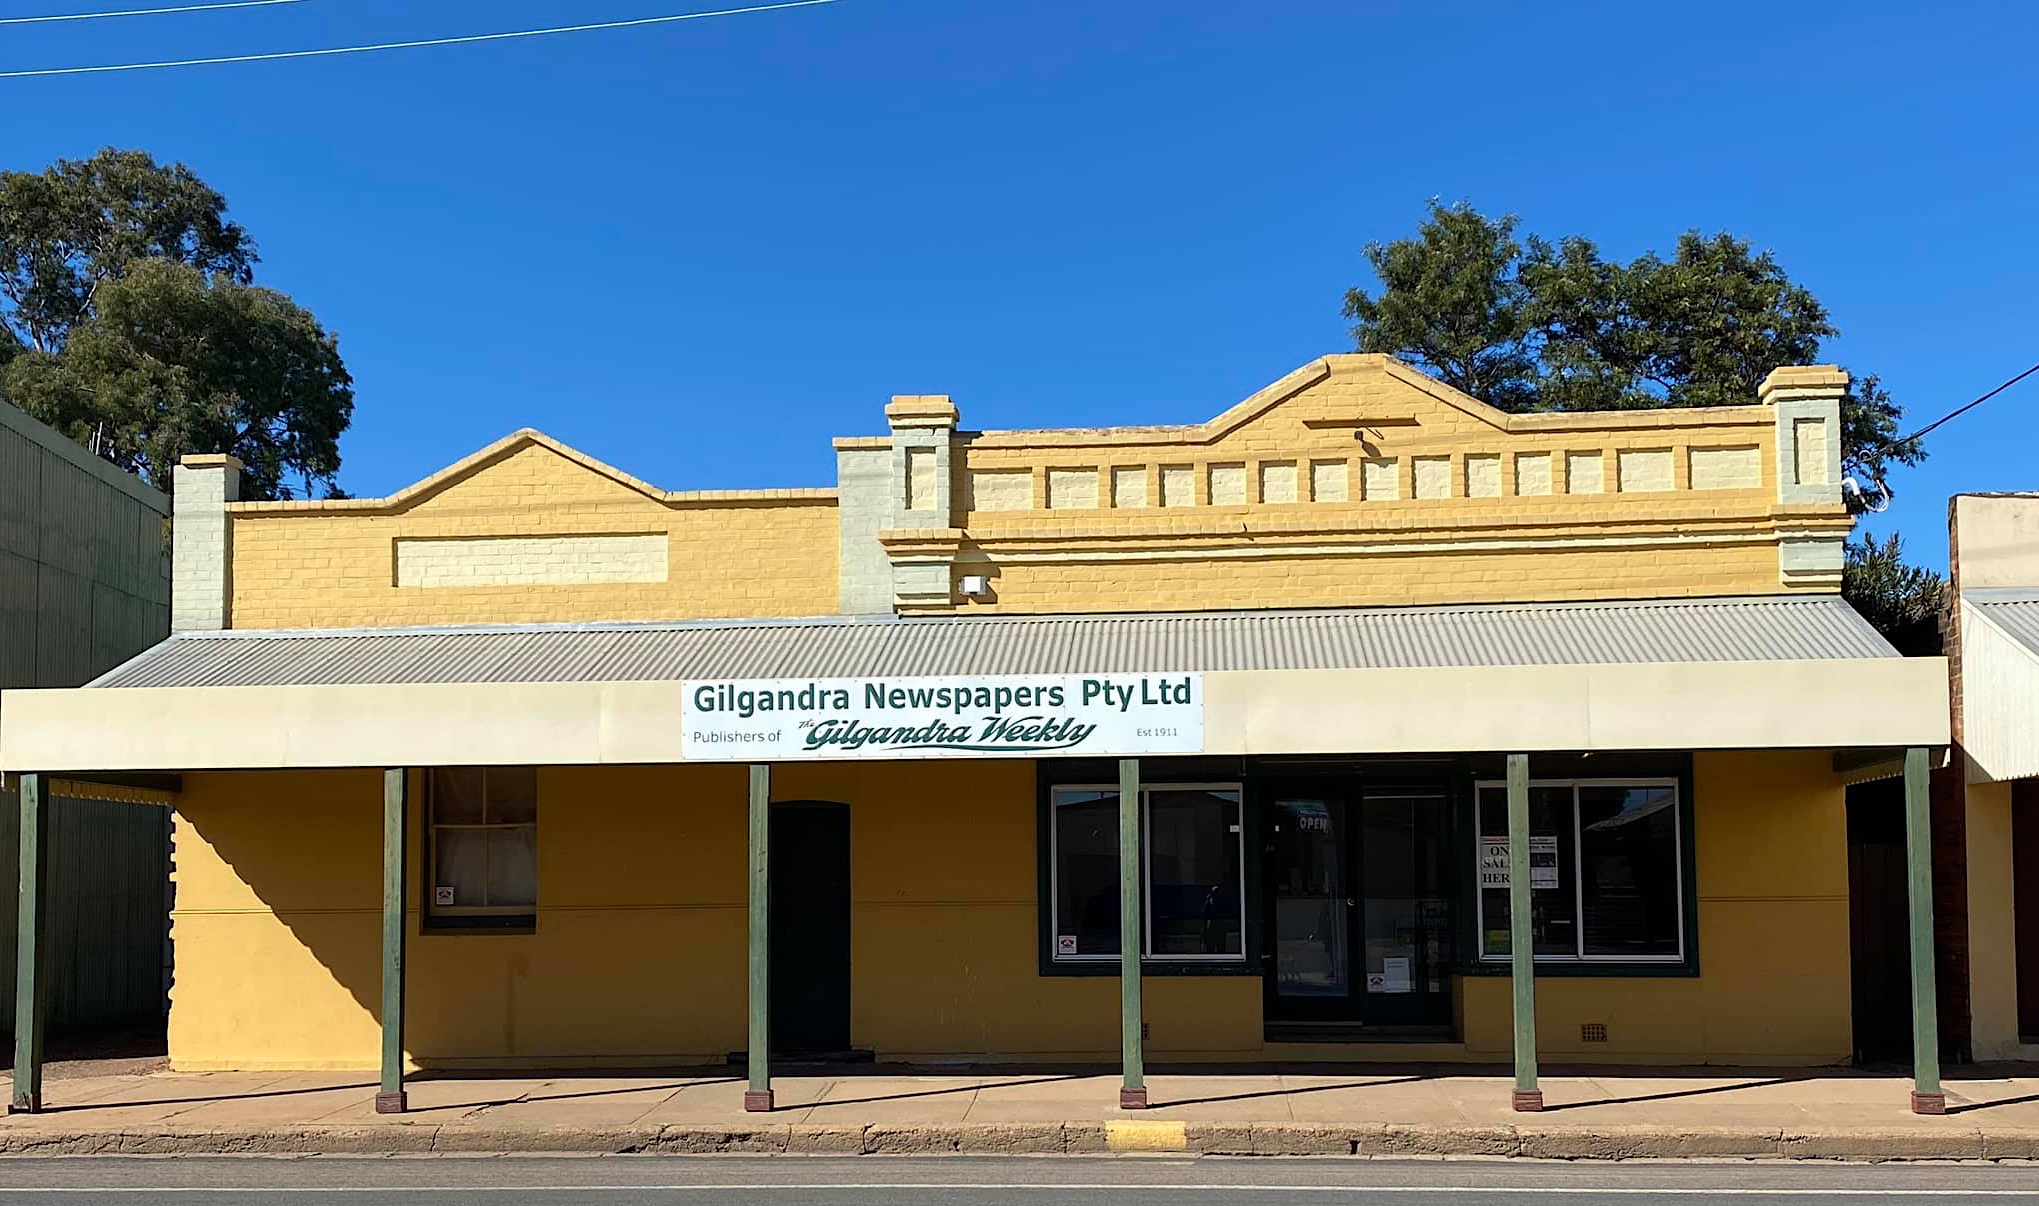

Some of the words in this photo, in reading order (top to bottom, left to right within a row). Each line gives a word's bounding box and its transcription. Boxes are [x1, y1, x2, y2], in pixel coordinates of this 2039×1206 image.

[693, 683, 849, 718] Gilgandra
[864, 682, 1064, 715] Newspapers
[1082, 679, 1135, 712] Pty
[1141, 677, 1191, 706] Ltd
[798, 718, 815, 729] The
[693, 730, 765, 744] Publishers
[767, 729, 782, 742] of
[802, 718, 972, 750] Gilgandra
[977, 716, 1098, 747] Weekly
[1136, 728, 1152, 737] Est
[1155, 727, 1178, 737] 1911
[1300, 817, 1328, 830] OPEN
[1482, 857, 1511, 868] SAL
[1482, 873, 1511, 883] HER
